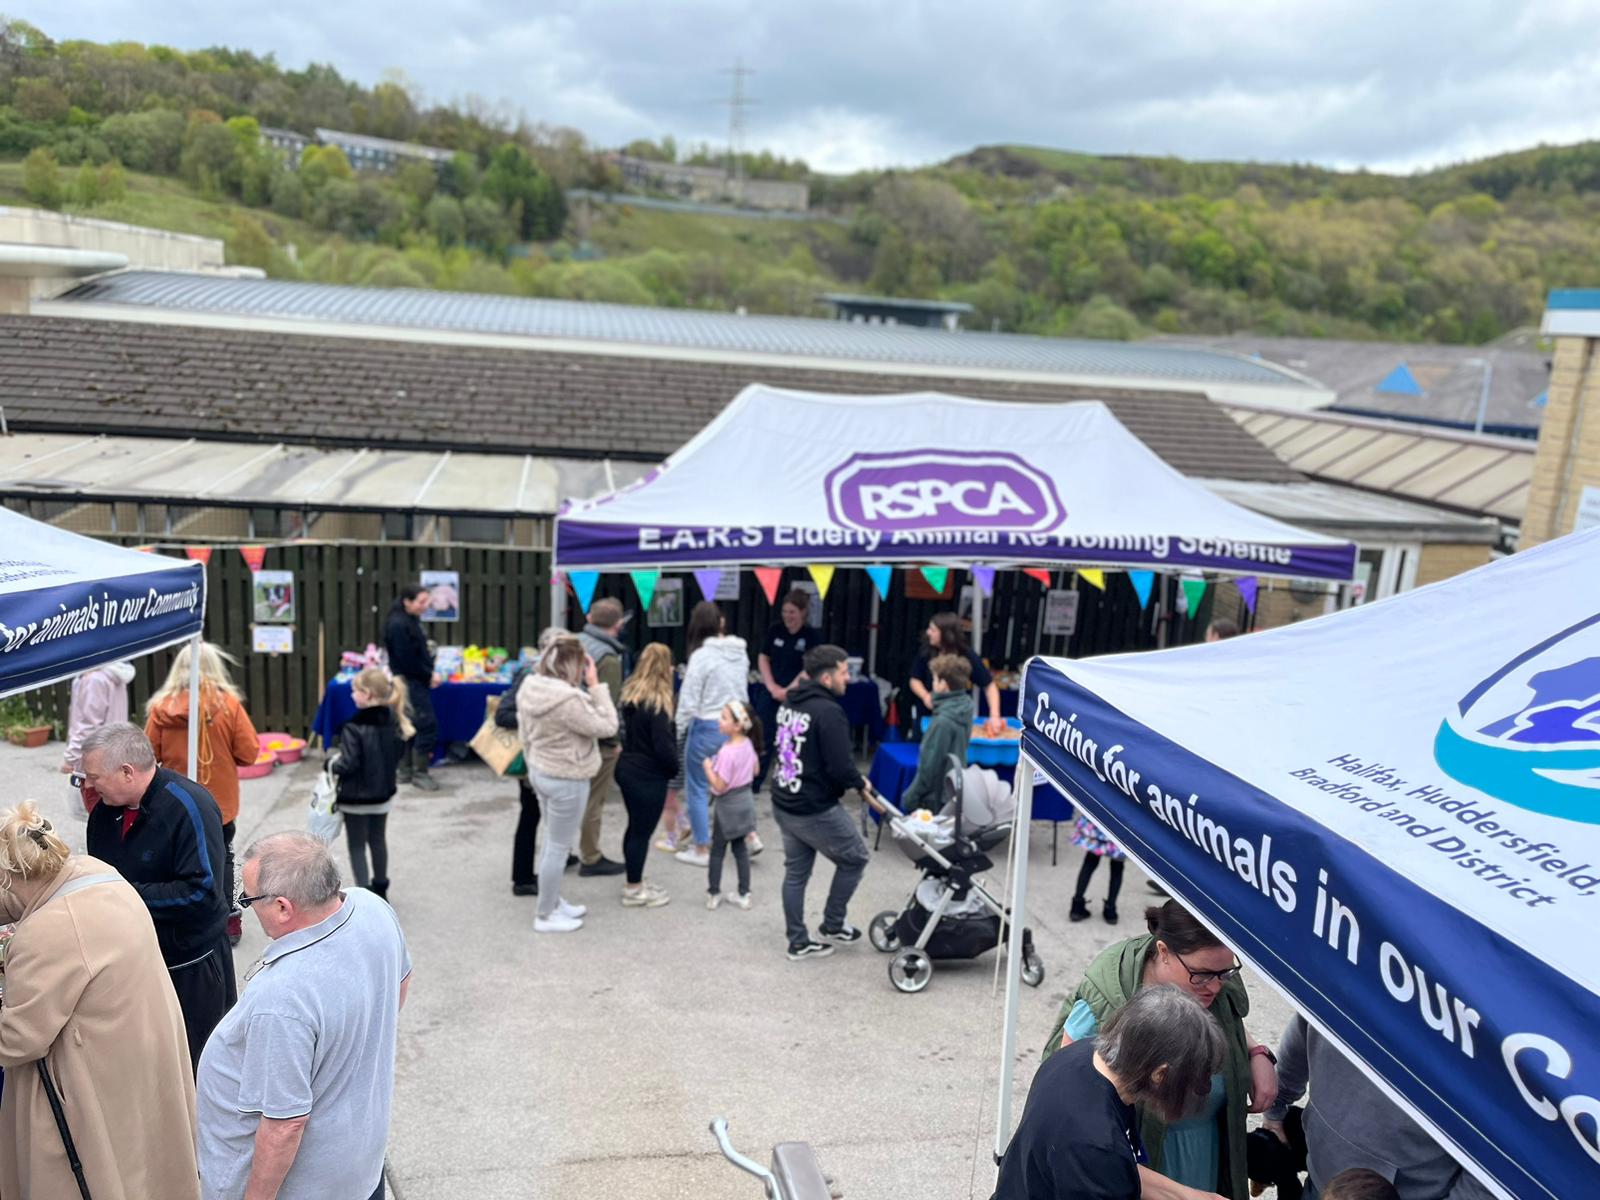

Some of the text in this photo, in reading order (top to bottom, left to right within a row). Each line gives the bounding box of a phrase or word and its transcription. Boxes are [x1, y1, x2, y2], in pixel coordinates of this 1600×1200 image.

[858, 478, 1036, 520] RSPCA
[638, 526, 763, 550] E.A.R.S
[774, 525, 882, 551] Elderly
[1177, 536, 1292, 565] Scheme
[30, 595, 99, 646] animals
[103, 592, 118, 627] in
[120, 597, 146, 624] our
[1327, 753, 1409, 791] Halifax,
[1289, 768, 1557, 908] Bradford and District
[1033, 692, 1106, 782] Caring
[1103, 745, 1142, 804] for
[1147, 784, 1298, 913] animals
[1313, 868, 1360, 965] in
[1380, 941, 1481, 1059] our
